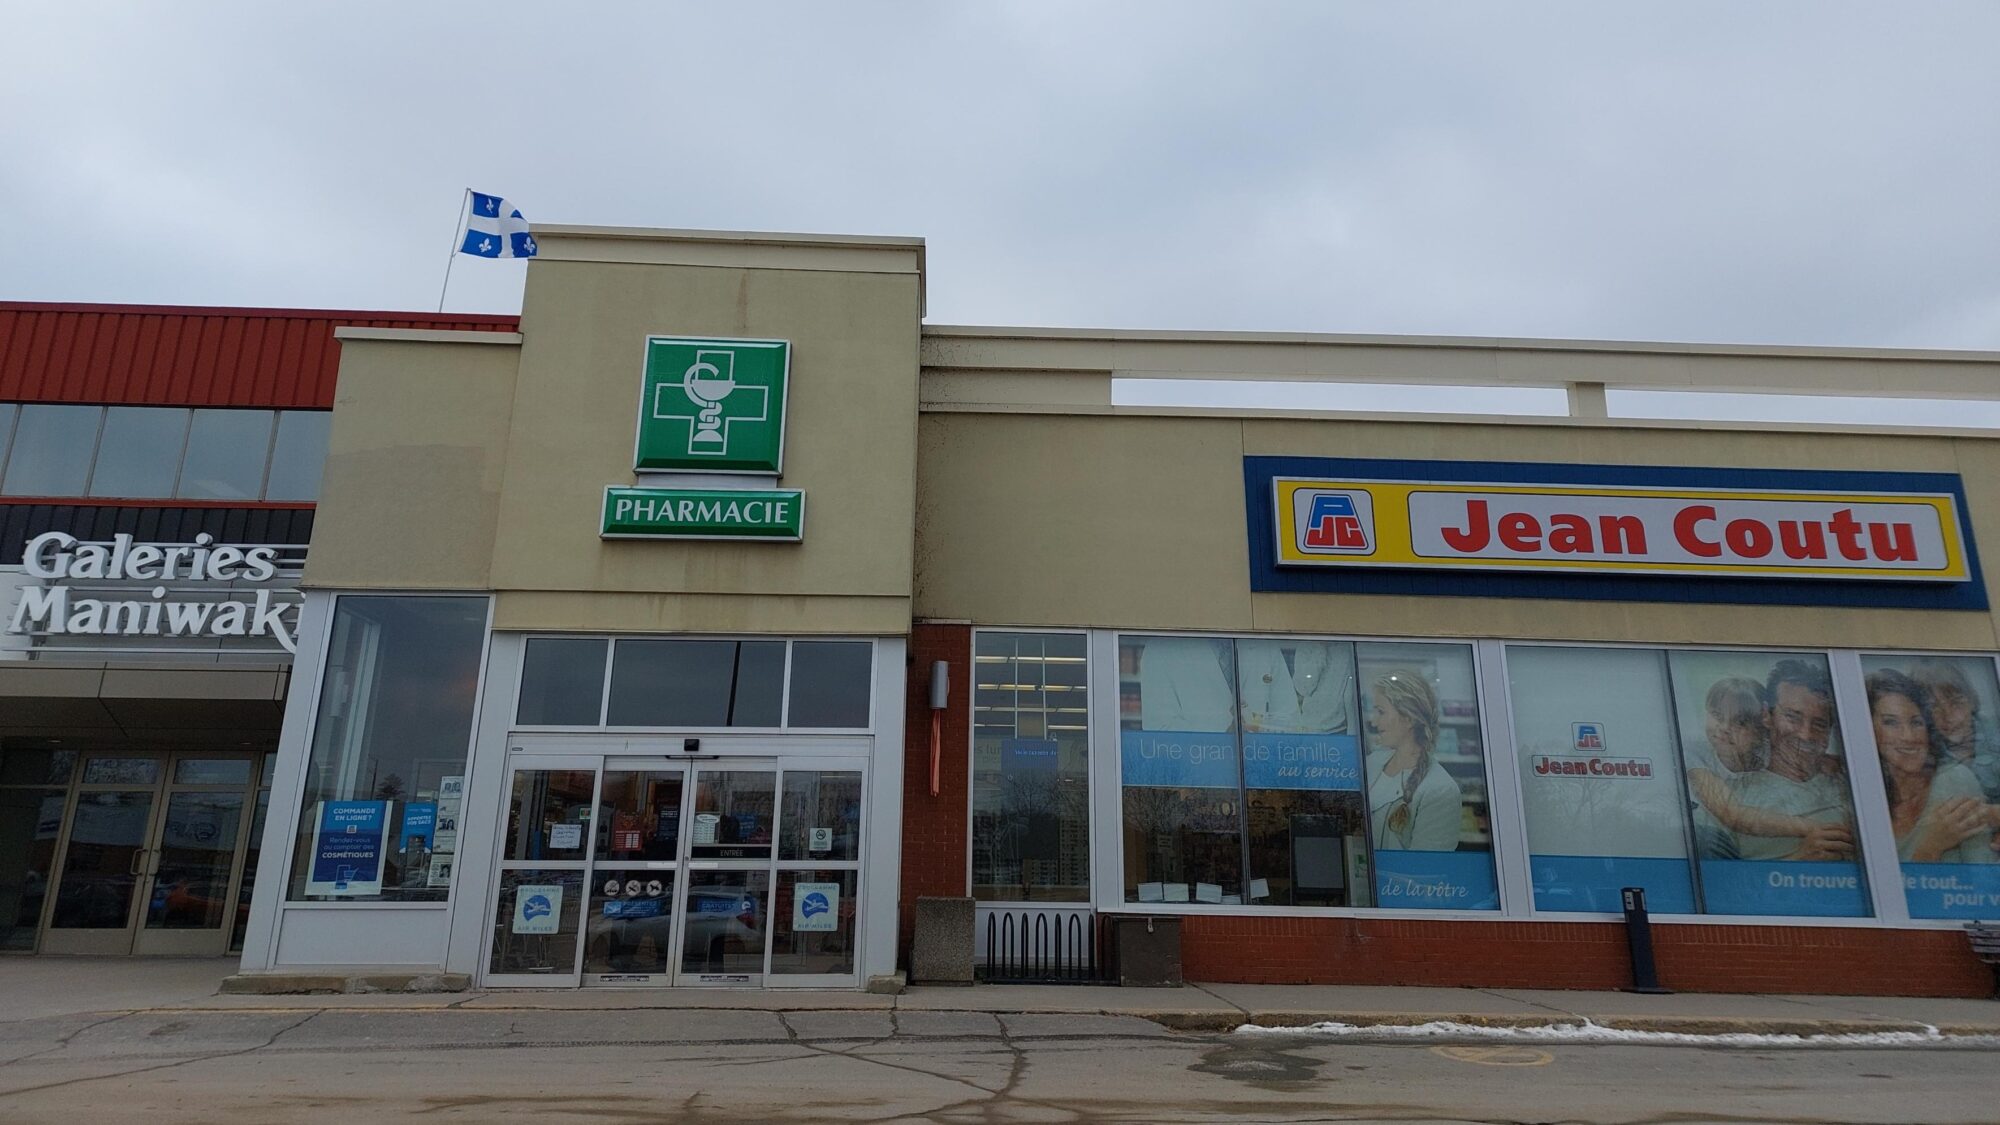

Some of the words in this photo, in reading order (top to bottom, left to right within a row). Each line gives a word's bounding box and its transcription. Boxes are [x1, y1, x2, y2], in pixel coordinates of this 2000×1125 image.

[615, 499, 789, 524] PHARMACIE
[1440, 499, 1648, 555] Jean
[1673, 505, 1918, 562] Coutu
[23, 531, 278, 581] Galeries
[1140, 738, 1182, 760] Une
[1278, 741, 1341, 763] famille
[1278, 766, 1300, 778] au
[1303, 764, 1359, 779] service
[1535, 757, 1588, 775] Jean
[1588, 758, 1652, 777] Coutu
[333, 807, 376, 815] COMMANDE
[321, 851, 374, 859] COSMÉTIQUES
[720, 848, 744, 857] ENTRÉE
[1381, 877, 1403, 896] de
[1405, 878, 1424, 896] la
[1426, 881, 1469, 898] vôtre
[1769, 870, 1794, 888] On
[1799, 872, 1857, 889] trouve
[1921, 874, 1974, 890] tout...
[1943, 892, 1987, 909] pour
